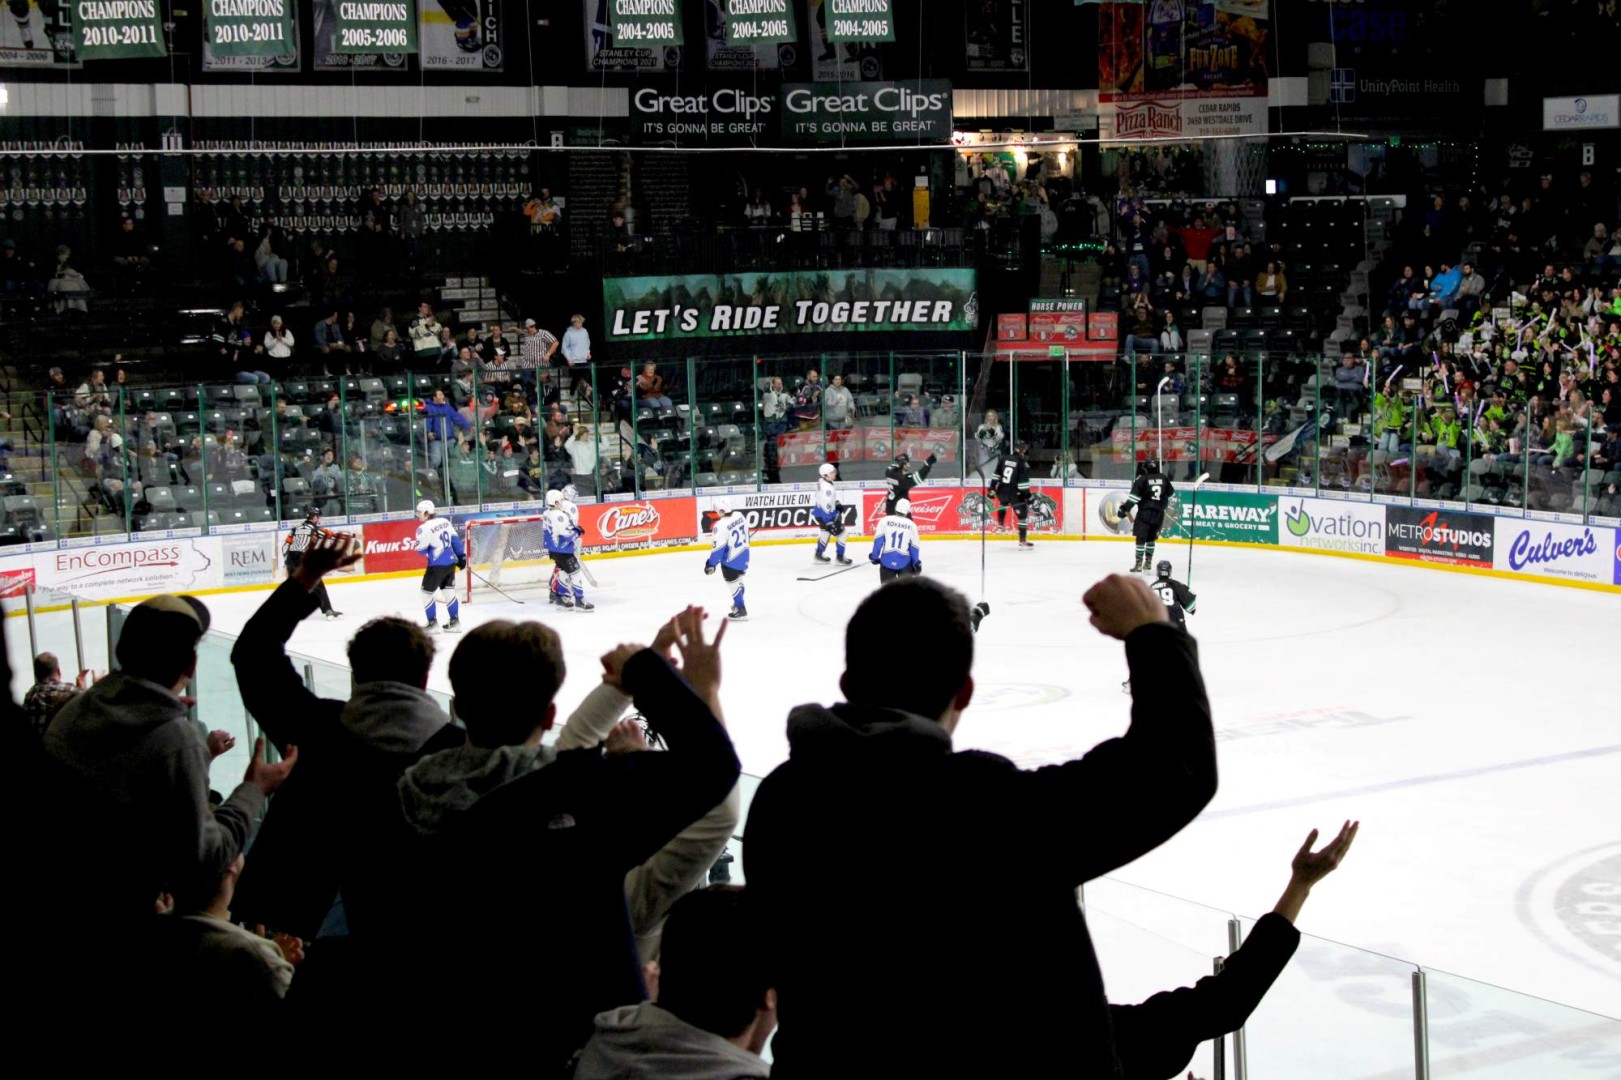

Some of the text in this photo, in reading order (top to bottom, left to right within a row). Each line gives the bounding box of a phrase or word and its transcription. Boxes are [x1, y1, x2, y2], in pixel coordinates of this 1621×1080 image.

[78, 0, 155, 20] CHAMPIONS
[211, 0, 284, 17] CHAMPIONS
[340, 2, 407, 21] CHAMPIONS
[615, 0, 675, 15] CHAMPIONS
[729, 0, 786, 15] CHAMPIONS
[832, 0, 888, 14] CHAMPIONS
[82, 24, 157, 46] 2010-2011
[215, 22, 284, 43] 2010-2011
[342, 28, 407, 46] 2005-2006
[617, 22, 674, 40] 2004-2005
[732, 20, 788, 39] 2004-2005
[834, 20, 888, 36] 2004-2005
[426, 56, 448, 65] 2016
[455, 56, 476, 65] 2017
[1360, 79, 1460, 96] UnityPoint Health
[634, 88, 771, 120] Great Clips
[786, 87, 942, 119] Great Clips
[1198, 103, 1241, 113] CEDAR RAPIDS
[795, 120, 932, 133] IT'S GONNA BE GREAT
[1116, 106, 1183, 134] Pizza Ranch
[1235, 113, 1253, 123] DRIVE
[643, 122, 763, 133] IT'S GONNA BE GREAT
[1582, 142, 1595, 166] B
[1031, 301, 1083, 311] HORSE POWER
[612, 300, 953, 336] LET'S RIDE TOGETHER
[1002, 466, 1014, 484] 9
[745, 494, 811, 507] WATCH LIVE ON
[1151, 485, 1162, 501] 3
[601, 504, 658, 538] Cane's
[1182, 503, 1269, 523] FAREWAY
[1224, 523, 1258, 531] GROCERY
[1388, 523, 1492, 548] METROSTUDIOS
[365, 540, 401, 554] KWIK
[890, 530, 904, 549] 11
[231, 549, 266, 567] REM
[1508, 527, 1597, 571] Culver's
[56, 546, 180, 571] EnCompass
[1543, 567, 1566, 576] Welcome
[84, 579, 115, 588] complete
